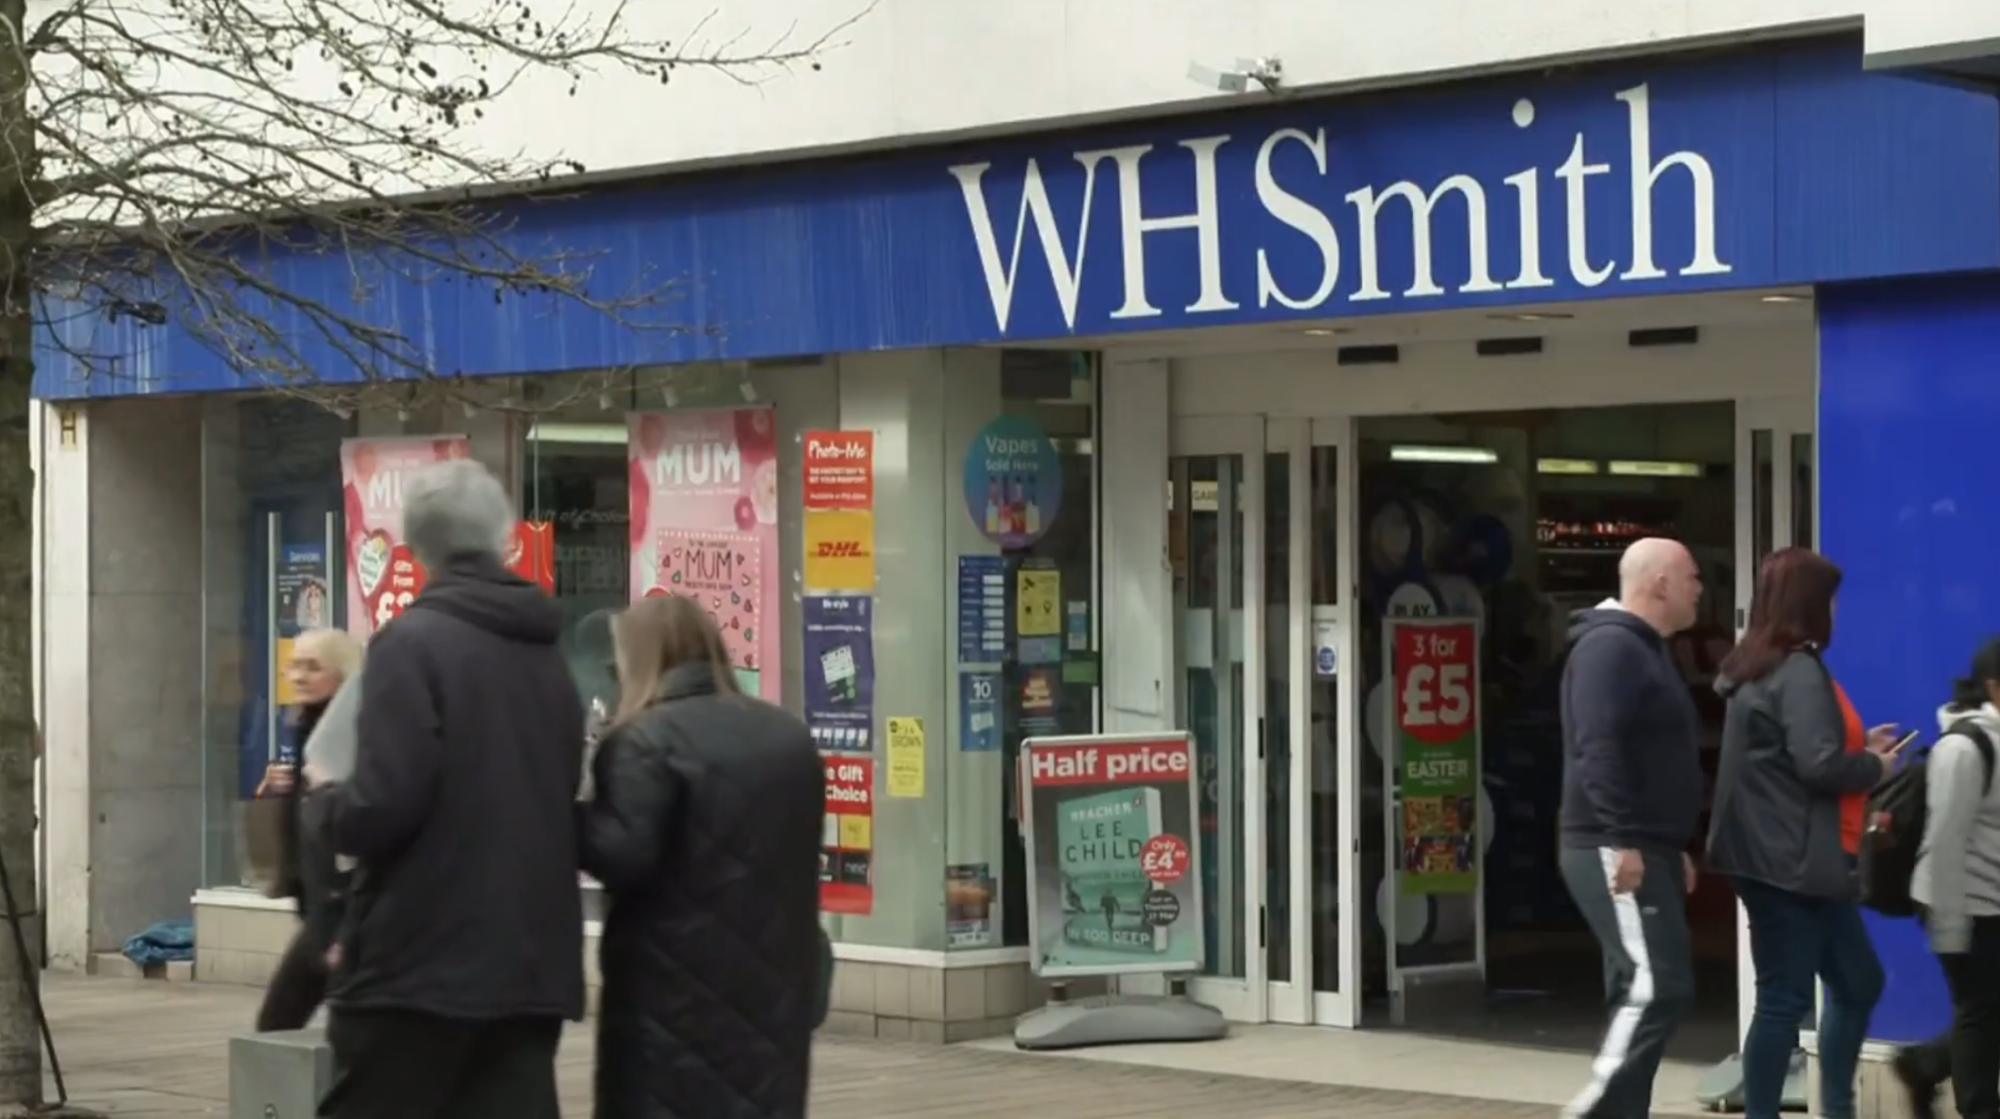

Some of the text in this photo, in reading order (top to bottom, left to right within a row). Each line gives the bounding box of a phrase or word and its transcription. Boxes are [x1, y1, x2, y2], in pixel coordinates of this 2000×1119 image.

[948, 82, 1731, 335] WHSmith
[61, 411, 76, 444] H
[808, 440, 866, 459] Photo-Me
[986, 436, 1038, 459] Vapes
[657, 443, 741, 485] MUM
[986, 459, 1010, 472] Sold
[817, 542, 862, 557] DHL
[685, 549, 732, 580] MUM
[1413, 633, 1458, 657] 3 for
[972, 681, 991, 698] 10
[1402, 664, 1470, 726] £5
[838, 764, 864, 782] Gift
[1032, 750, 1098, 778] Half
[1107, 747, 1187, 781] price
[1407, 759, 1469, 779] EASTER
[1070, 801, 1132, 822] REACHER
[1080, 820, 1122, 840] LEE
[1065, 838, 1143, 863] CHILD
[1151, 841, 1176, 854] Only
[1113, 930, 1151, 945] DEEP
